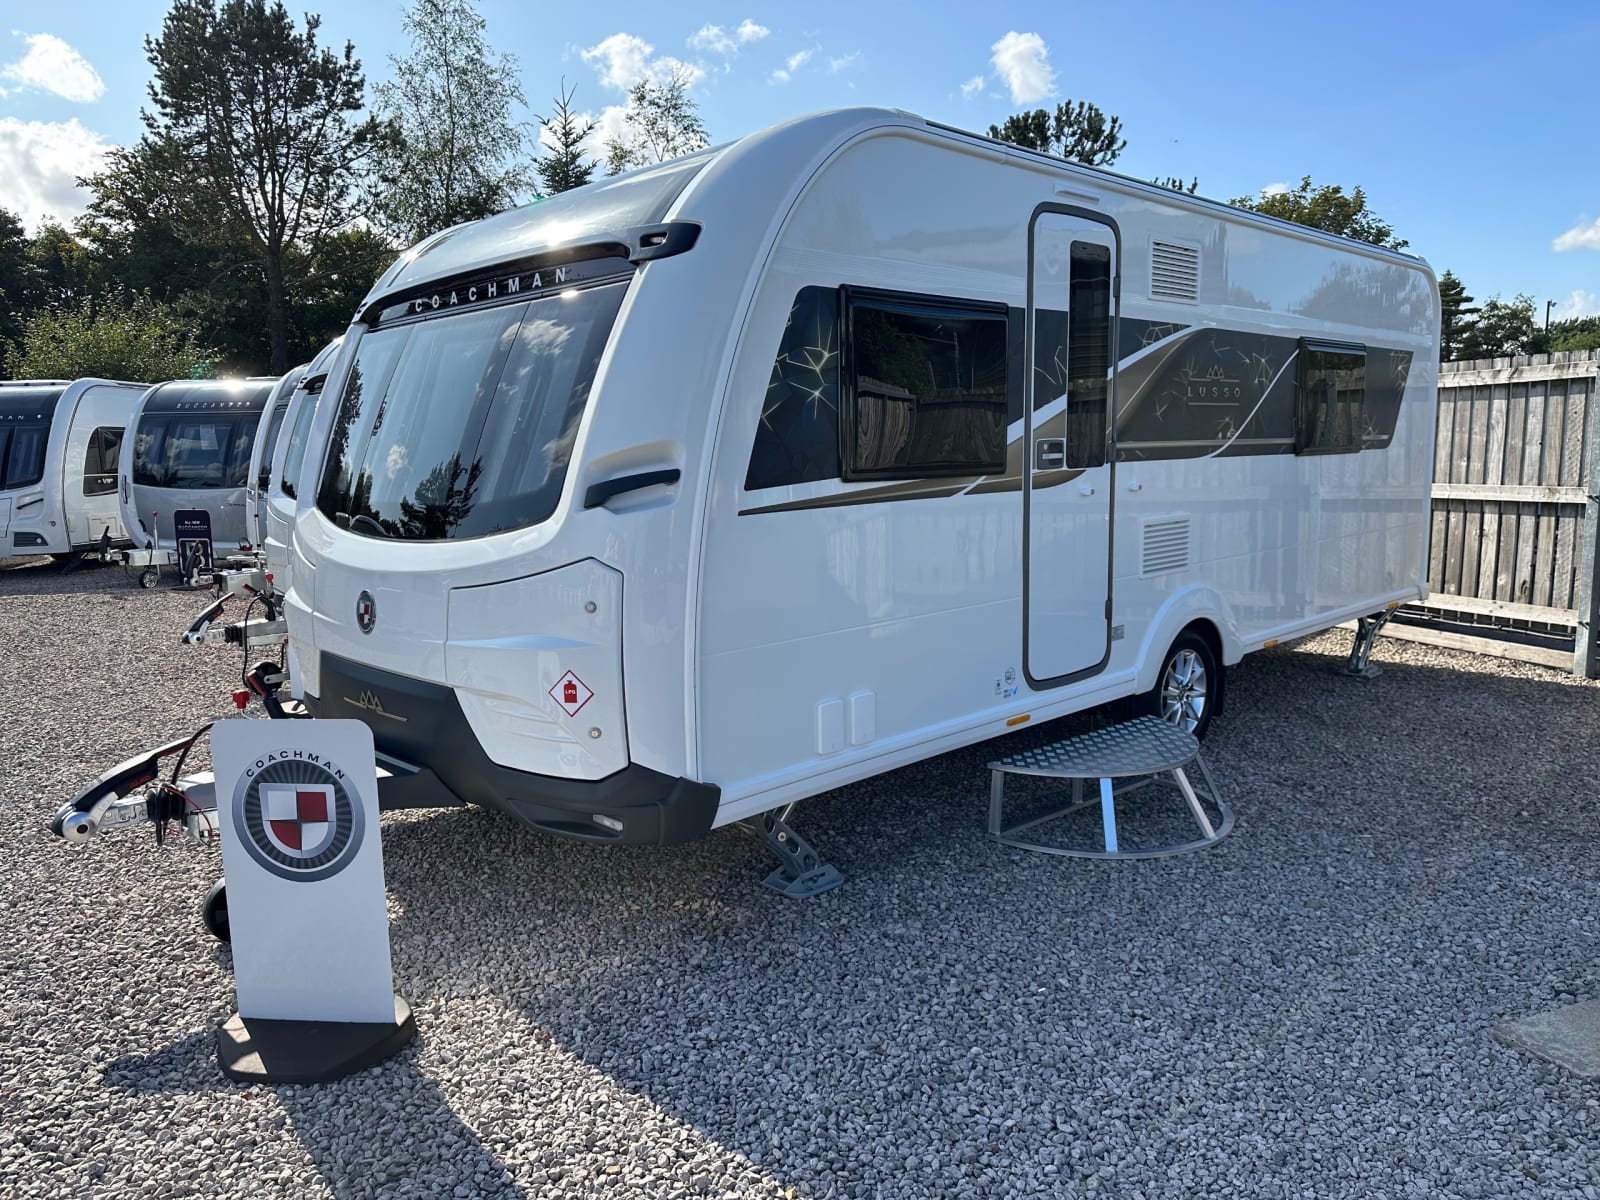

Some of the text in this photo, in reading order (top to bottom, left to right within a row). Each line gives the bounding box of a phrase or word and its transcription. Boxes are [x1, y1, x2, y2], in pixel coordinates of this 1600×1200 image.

[414, 266, 566, 313] COACHMAN
[1187, 386, 1241, 398] LUSSO
[176, 401, 251, 409] BUCCANEER
[246, 750, 345, 779] COACHMAN
